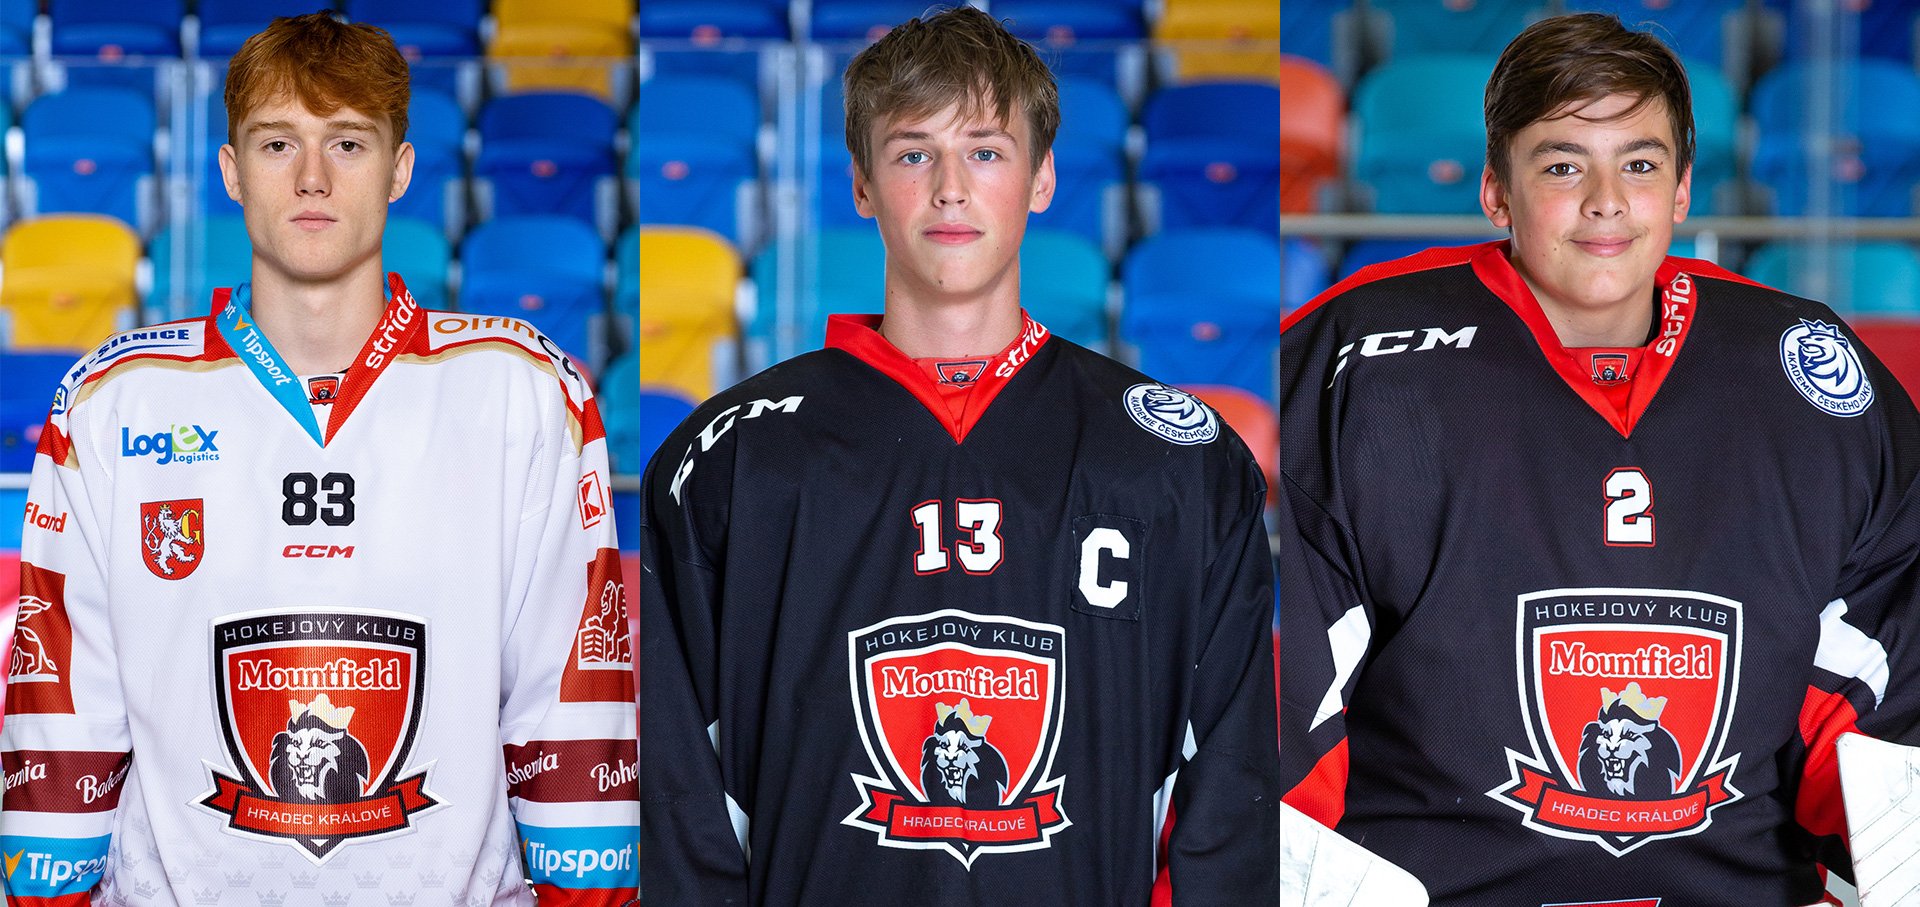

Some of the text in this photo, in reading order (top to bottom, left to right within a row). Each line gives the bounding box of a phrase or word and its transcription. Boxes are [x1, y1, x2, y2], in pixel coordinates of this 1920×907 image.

[71, 329, 189, 382] M-SILNICE
[242, 328, 292, 386] Tipsport
[1787, 350, 1817, 398] AKADEMIE
[1131, 395, 1158, 427] AKADEMIE
[173, 452, 220, 464] Logistics
[669, 396, 804, 506] CCM
[282, 472, 355, 527] 83
[1603, 467, 1656, 547] 2
[282, 545, 355, 558] CCM
[911, 498, 1004, 576] 13
[1079, 527, 1130, 609] C
[224, 618, 417, 642] HOKEJOVÝ KLUB
[1535, 601, 1728, 626] HOKEJOVÝ KLUB
[865, 622, 1054, 652] HOKEJOVÝ KLUB
[238, 658, 401, 690] Mountfield
[1550, 641, 1713, 679] Mountfield
[882, 666, 1039, 700] Mountfield
[505, 751, 560, 791] ohemia
[247, 805, 392, 825] HRADEC KRÁLOVÉ
[903, 815, 964, 828] HRADEC
[1552, 801, 1699, 823] HRADEC KRÁLOVÉ
[530, 842, 632, 878] Tipsport
